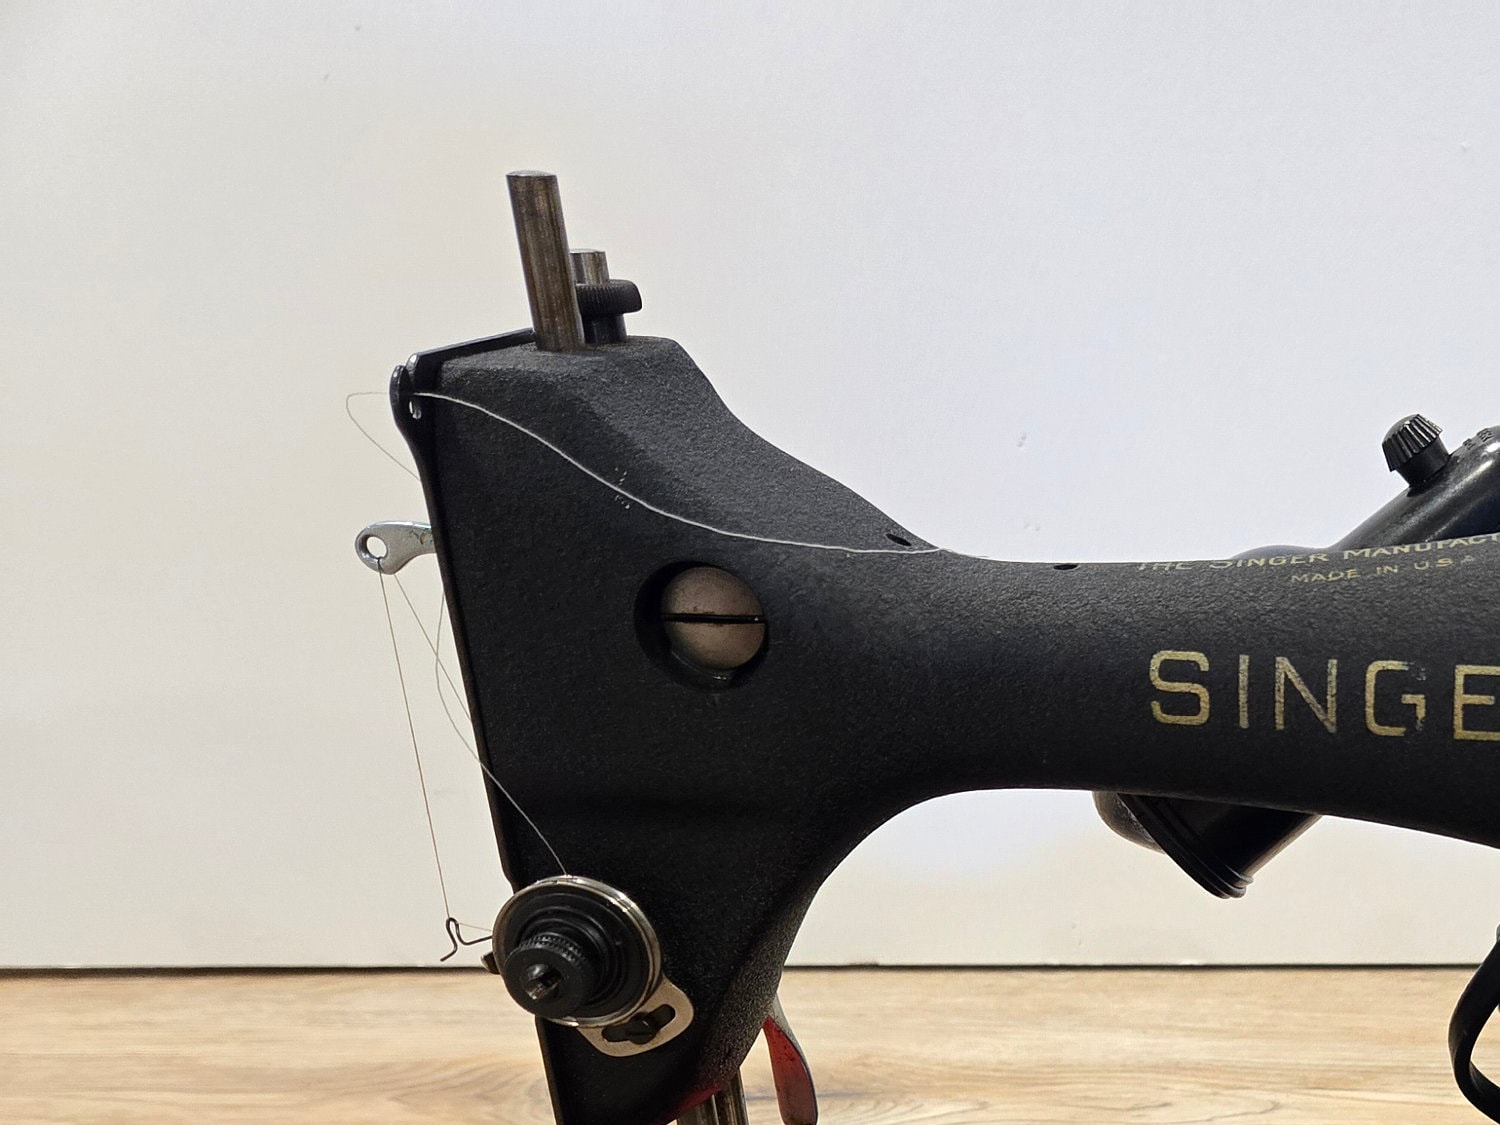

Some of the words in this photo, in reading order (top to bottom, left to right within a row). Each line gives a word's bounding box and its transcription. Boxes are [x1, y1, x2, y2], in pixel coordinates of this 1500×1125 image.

[1209, 553, 1329, 569] SINGER
[1291, 568, 1360, 582] MADE
[1376, 565, 1398, 575] IN
